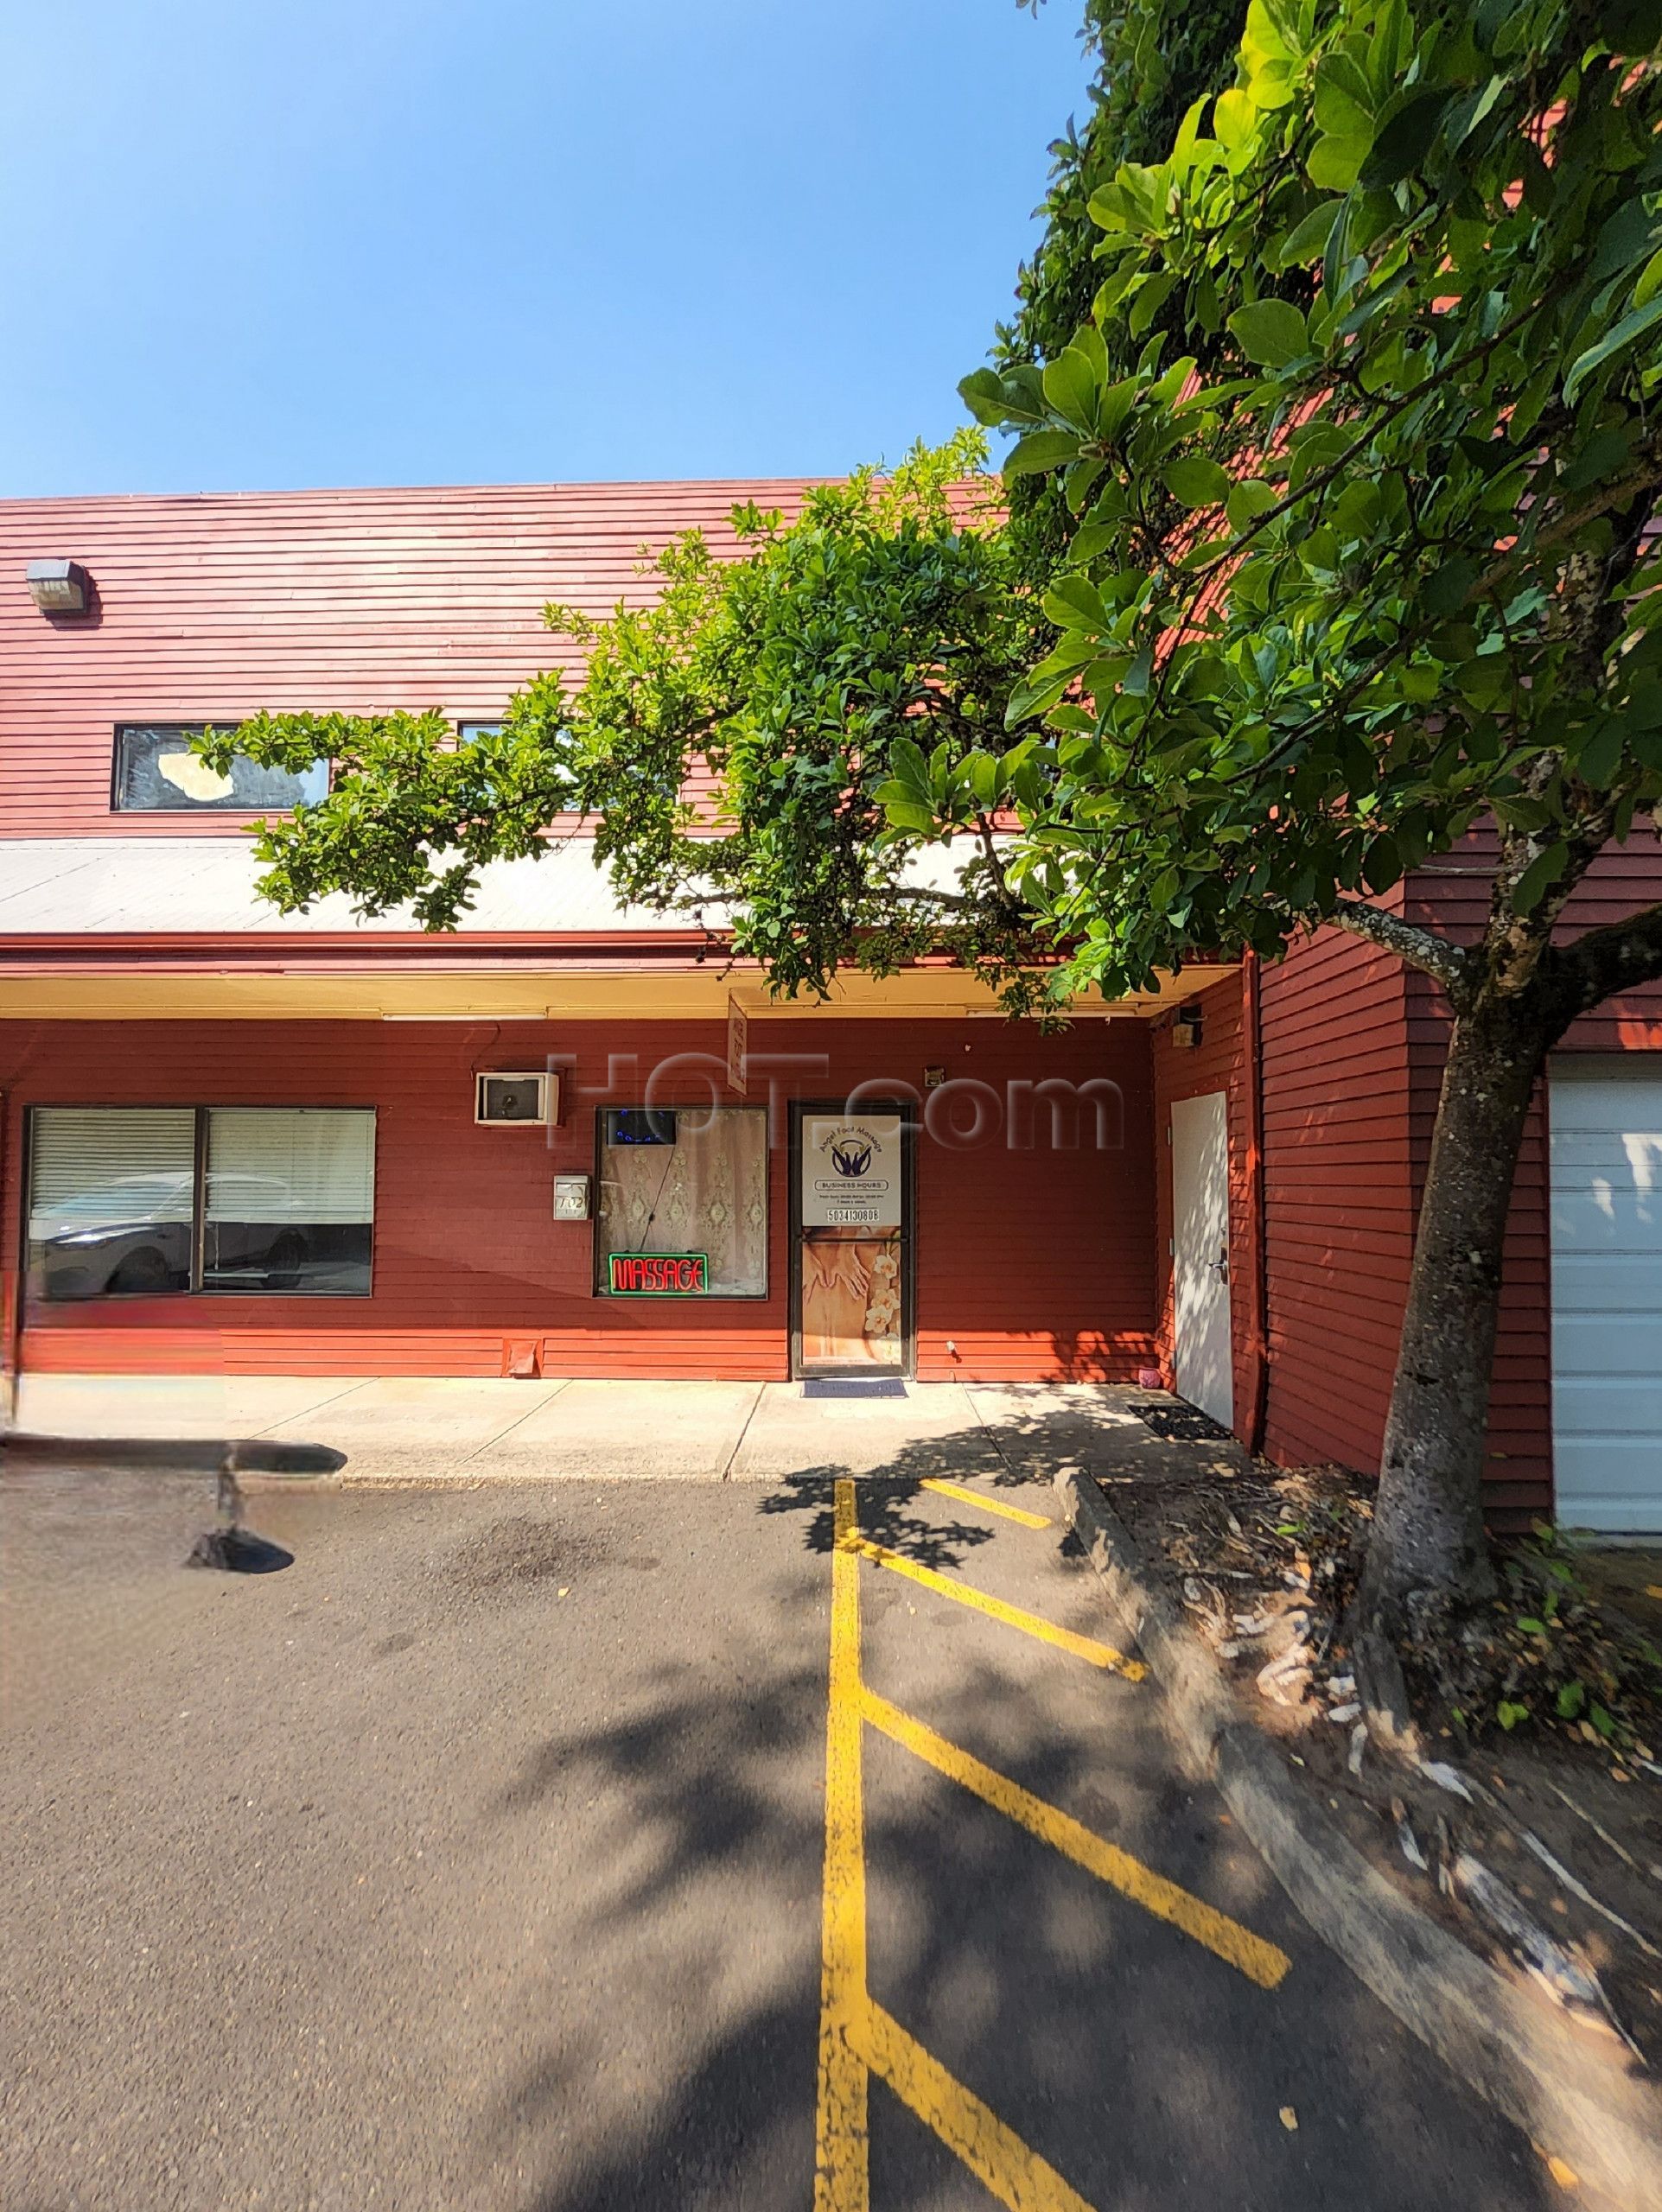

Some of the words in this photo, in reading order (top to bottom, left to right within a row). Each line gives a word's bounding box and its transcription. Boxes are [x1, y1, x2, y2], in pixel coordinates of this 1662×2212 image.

[819, 1130, 837, 1153] Angel
[856, 1126, 882, 1153] Massage
[613, 1258, 704, 1292] MASSAGE
